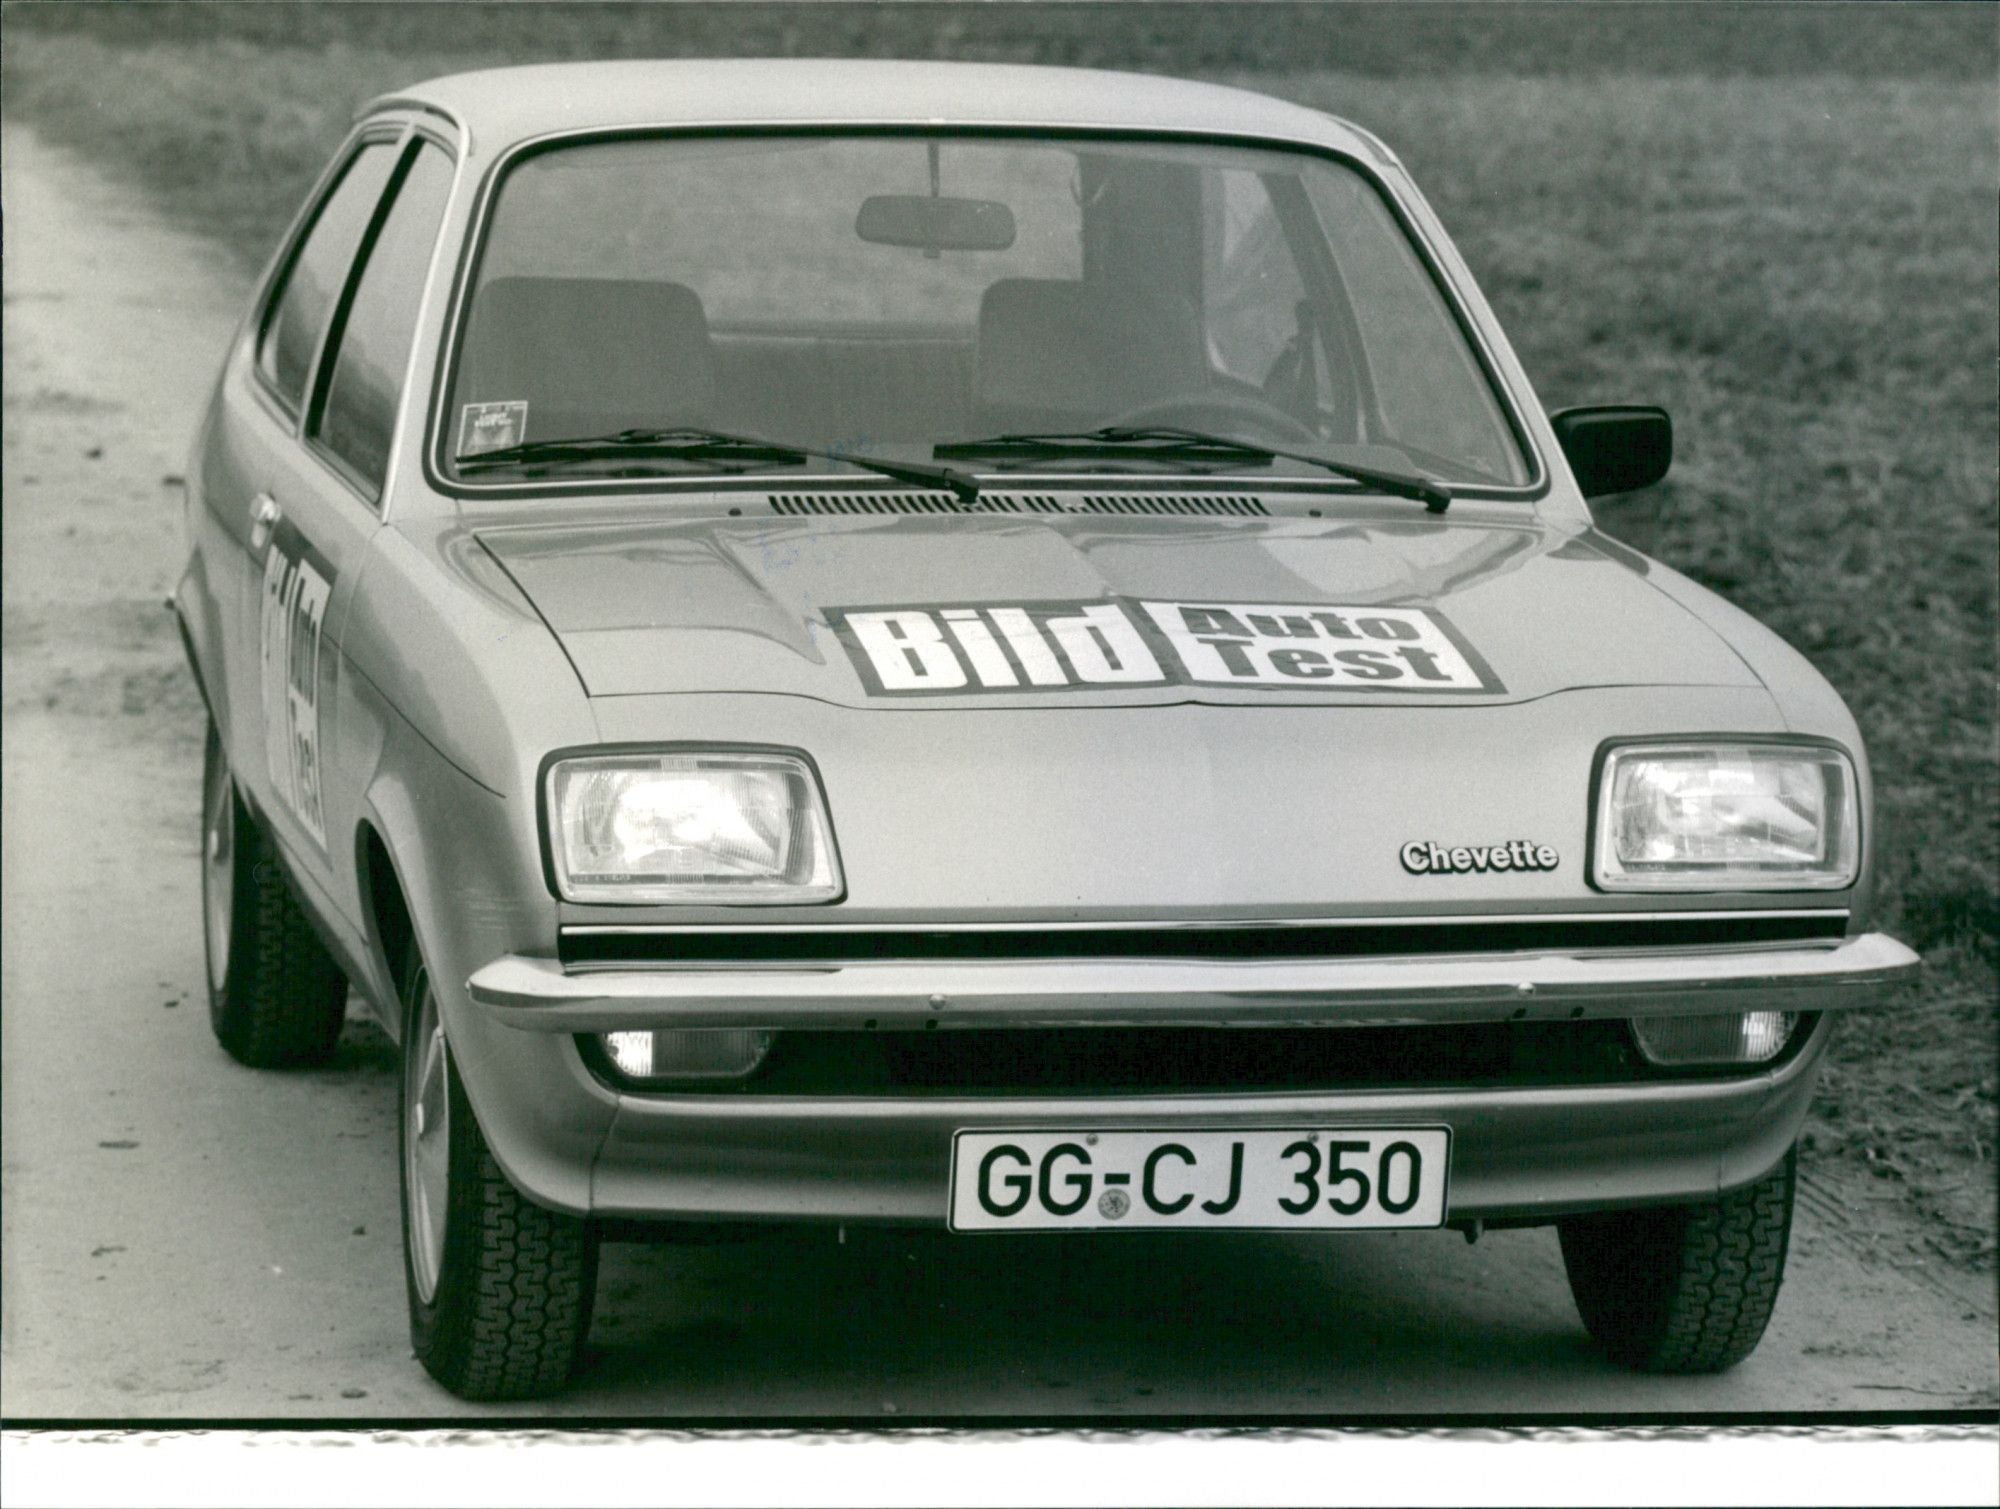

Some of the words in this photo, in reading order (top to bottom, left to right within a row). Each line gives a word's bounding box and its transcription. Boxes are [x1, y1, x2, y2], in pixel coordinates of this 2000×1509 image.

[1178, 607, 1420, 640] Auto
[844, 604, 1166, 689] Bild
[1196, 637, 1453, 681] Test
[1400, 840, 1559, 875] Chevette
[978, 1142, 1245, 1217] GG-CJ
[1277, 1141, 1422, 1215] 350
